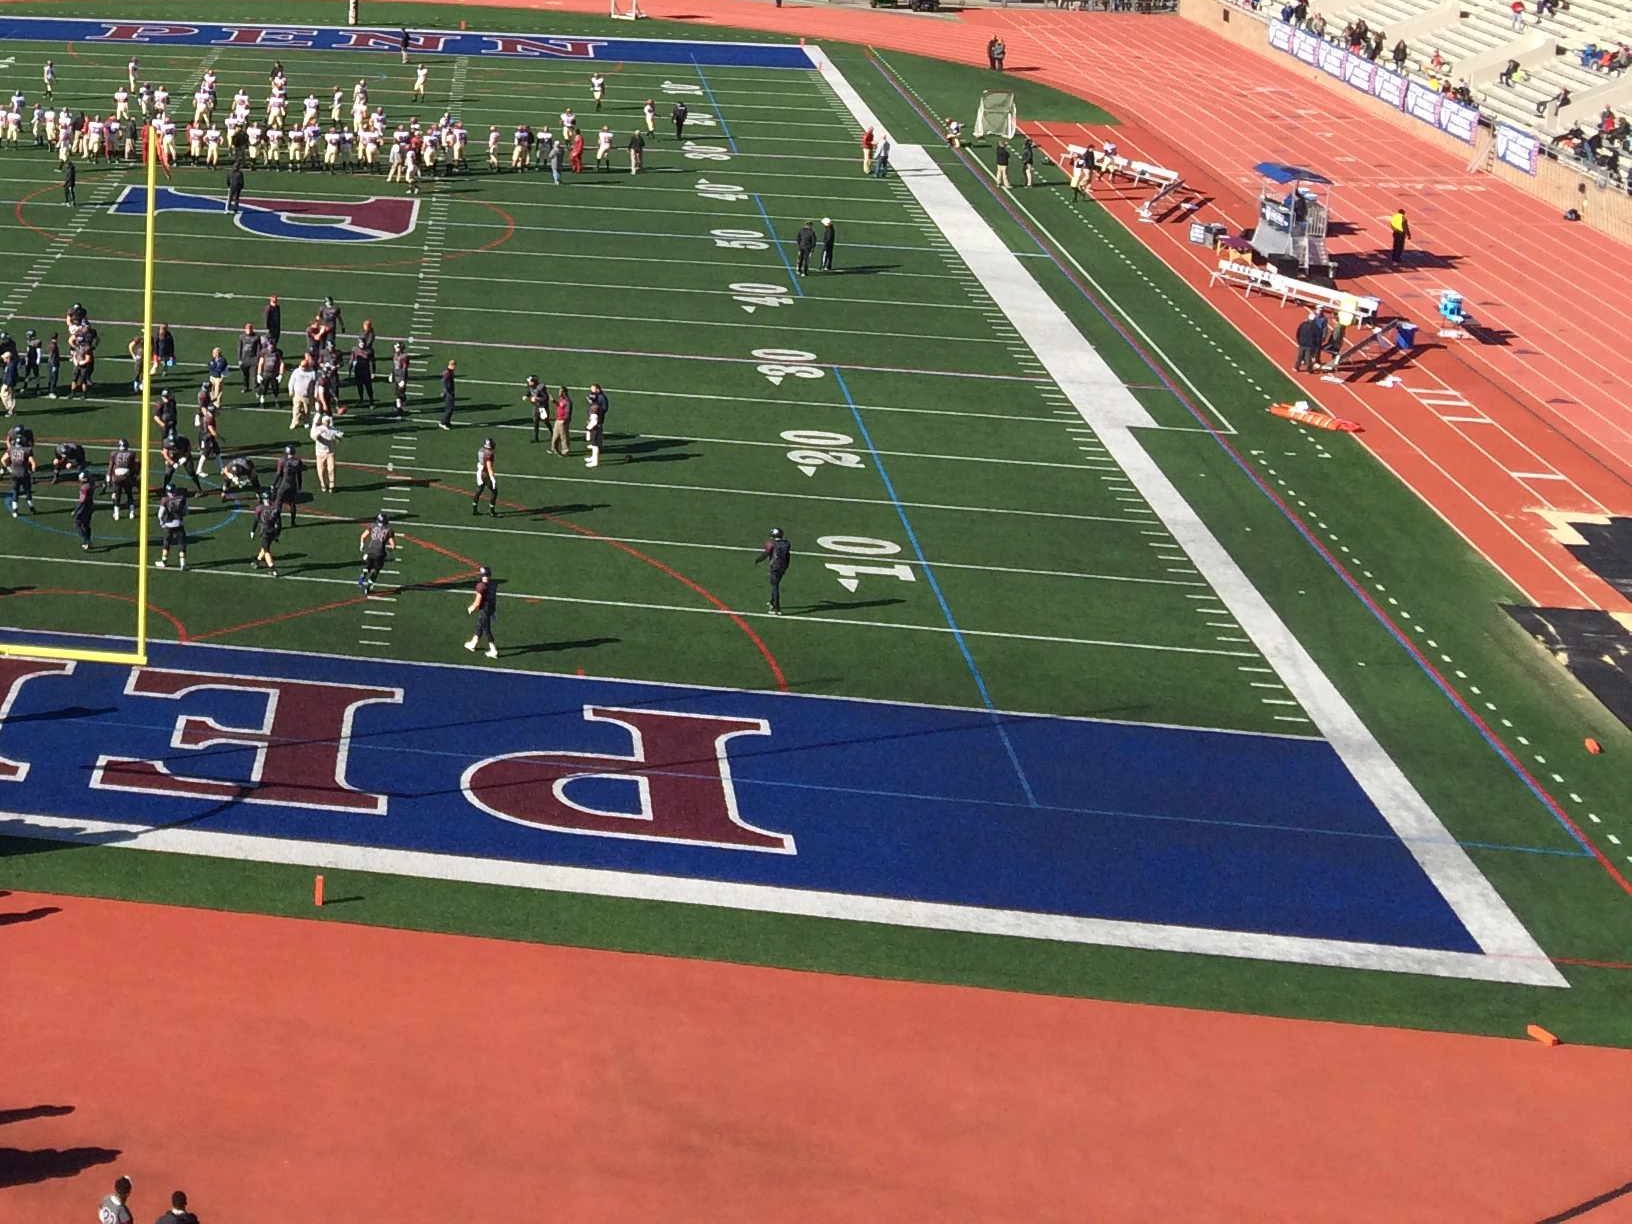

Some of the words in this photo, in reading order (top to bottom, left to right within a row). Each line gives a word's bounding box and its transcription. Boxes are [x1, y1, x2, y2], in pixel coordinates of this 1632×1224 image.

[85, 23, 608, 59] PENN
[751, 349, 825, 378] 30
[779, 430, 865, 468] 20
[817, 535, 916, 582] 10
